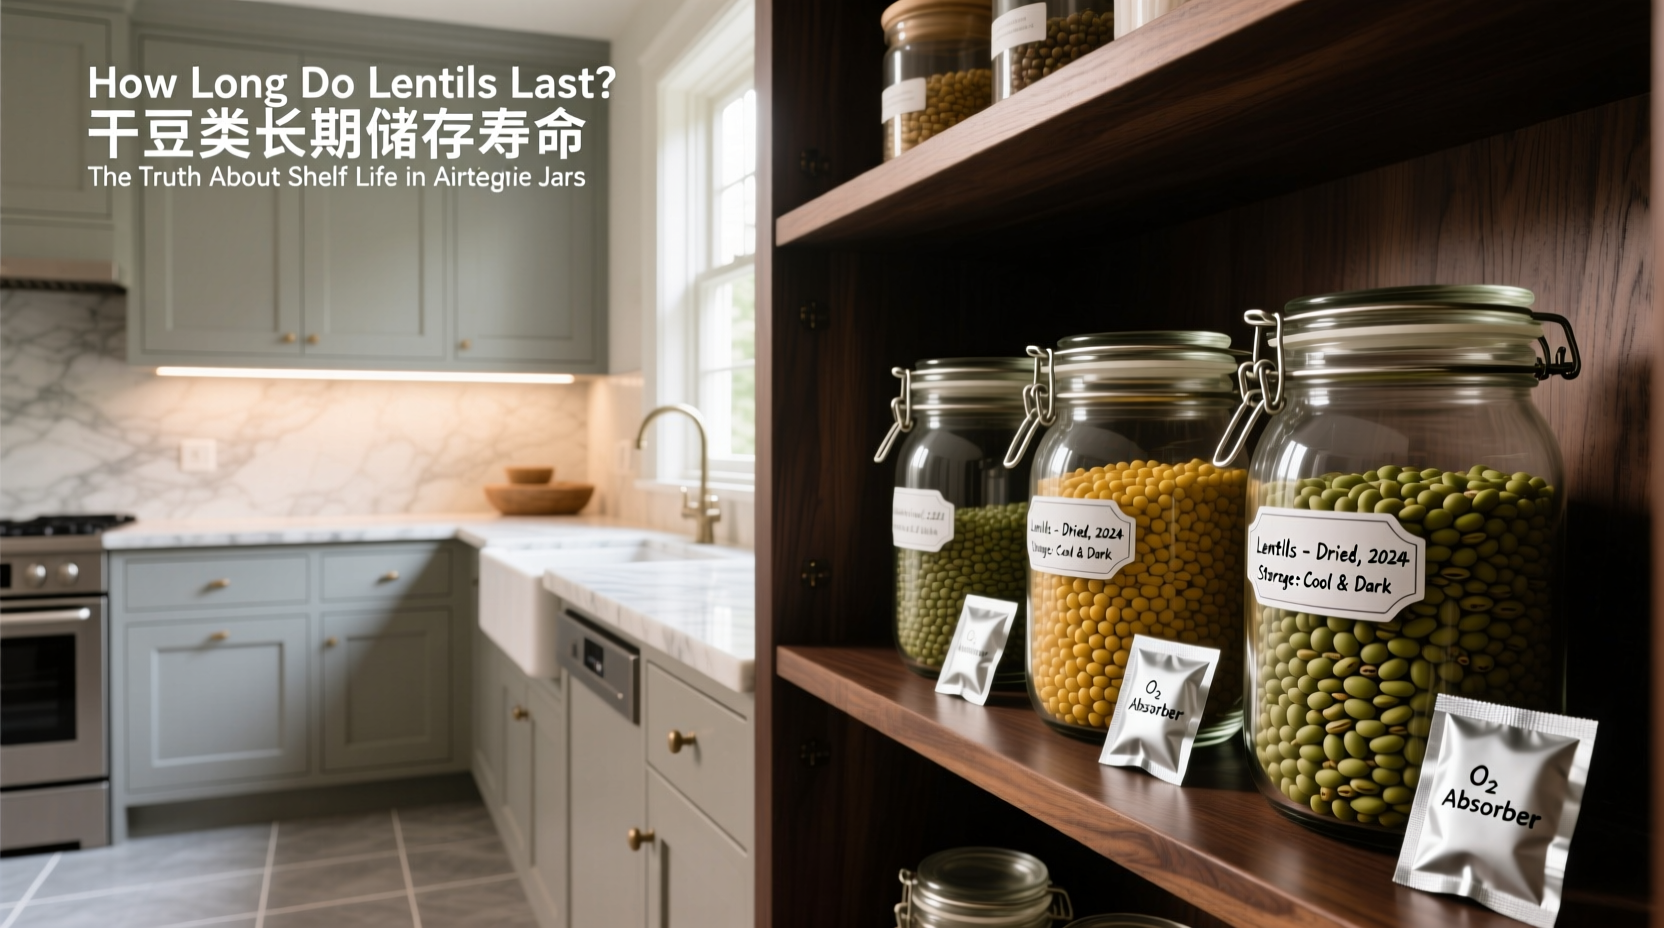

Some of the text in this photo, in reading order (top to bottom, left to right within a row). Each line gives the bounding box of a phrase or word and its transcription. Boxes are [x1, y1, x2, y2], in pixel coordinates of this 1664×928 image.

[1062, 522, 1091, 541] Dried,
[1095, 527, 1125, 541] 2024
[1087, 546, 1113, 561] Dark
[1316, 541, 1362, 568] Dried,
[1367, 548, 1411, 568] 2024
[1303, 570, 1333, 591] Cool
[1336, 573, 1349, 592] &
[1354, 574, 1392, 595] Dark
[1441, 788, 1542, 830] Absorber
